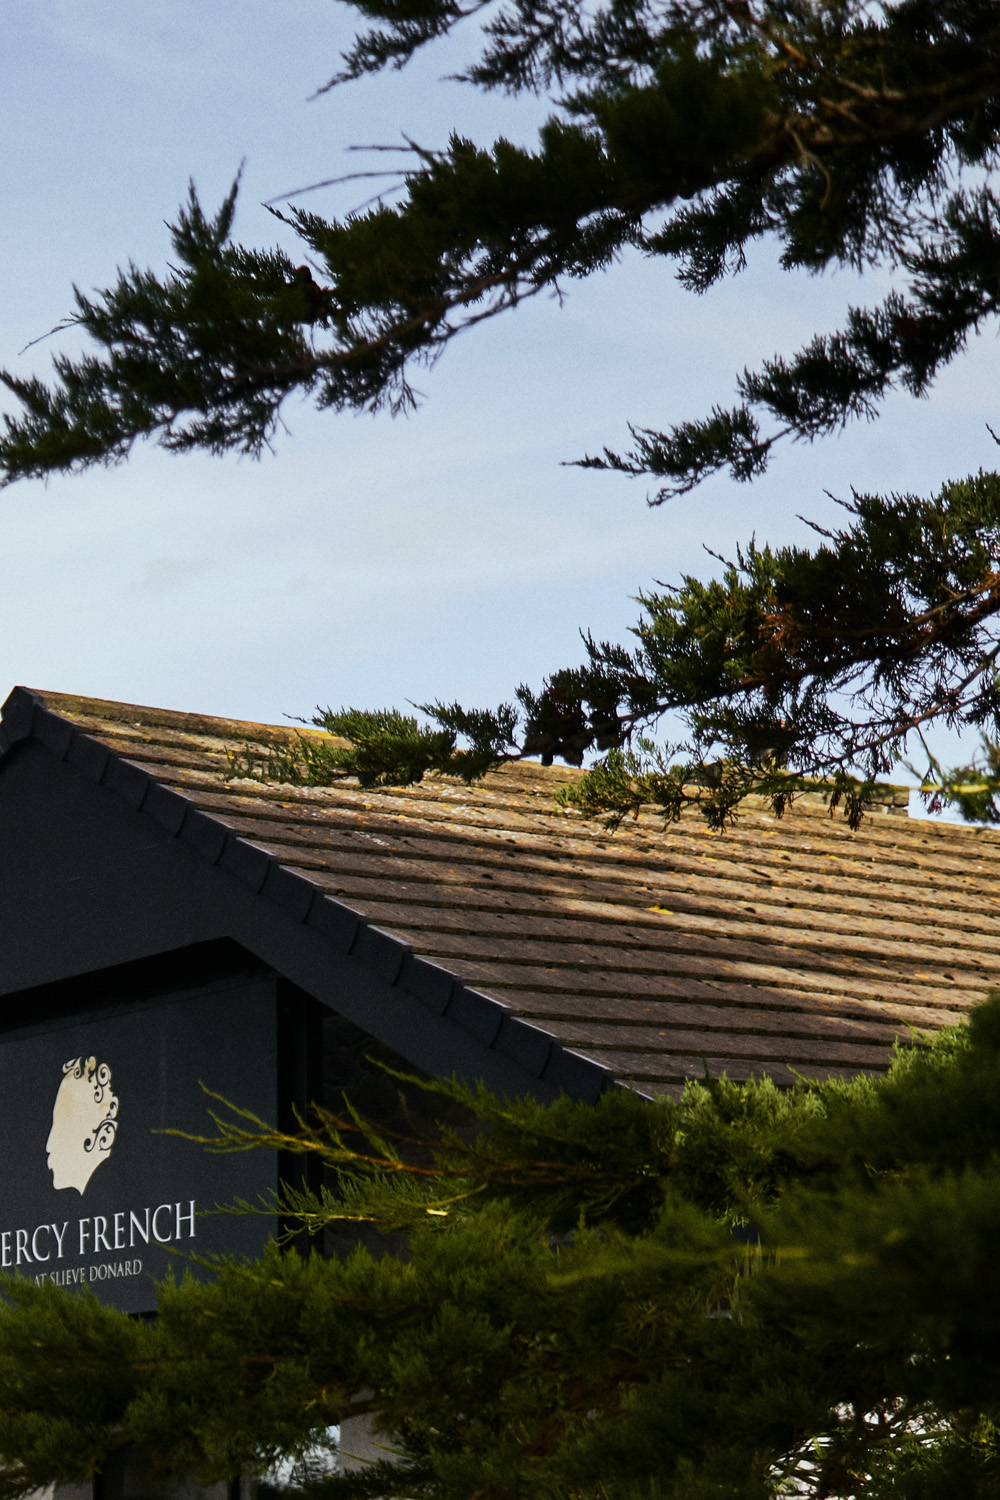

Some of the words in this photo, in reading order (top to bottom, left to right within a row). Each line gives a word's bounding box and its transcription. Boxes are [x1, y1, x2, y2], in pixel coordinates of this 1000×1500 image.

[78, 1200, 196, 1255] FRENCH
[49, 1266, 86, 1288] SLIEVE
[89, 1259, 142, 1282] DONARD
